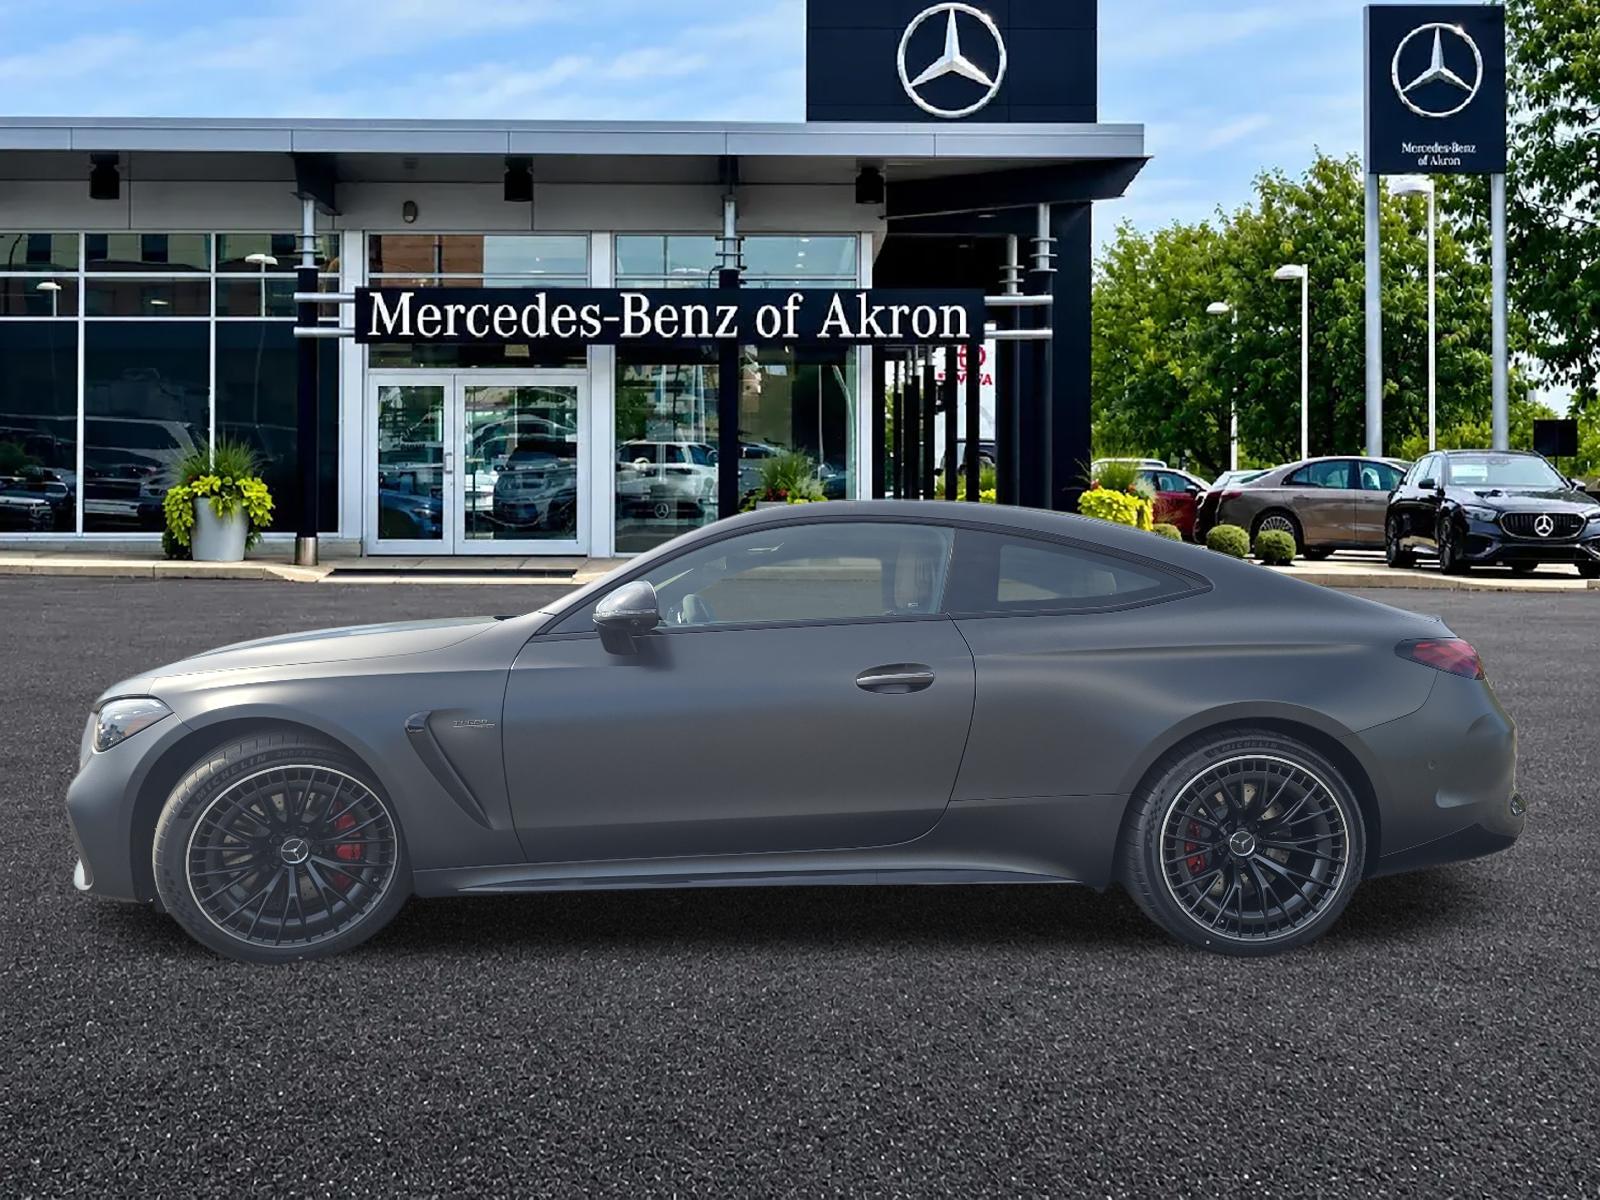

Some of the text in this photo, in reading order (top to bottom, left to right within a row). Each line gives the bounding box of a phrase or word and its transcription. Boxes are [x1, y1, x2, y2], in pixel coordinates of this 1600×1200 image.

[1401, 141, 1477, 154] Mercedes-Benz
[1417, 154, 1461, 166] of Akron
[367, 291, 970, 338] Mercedes-Benz of Akron
[195, 754, 268, 803] MICHELIN
